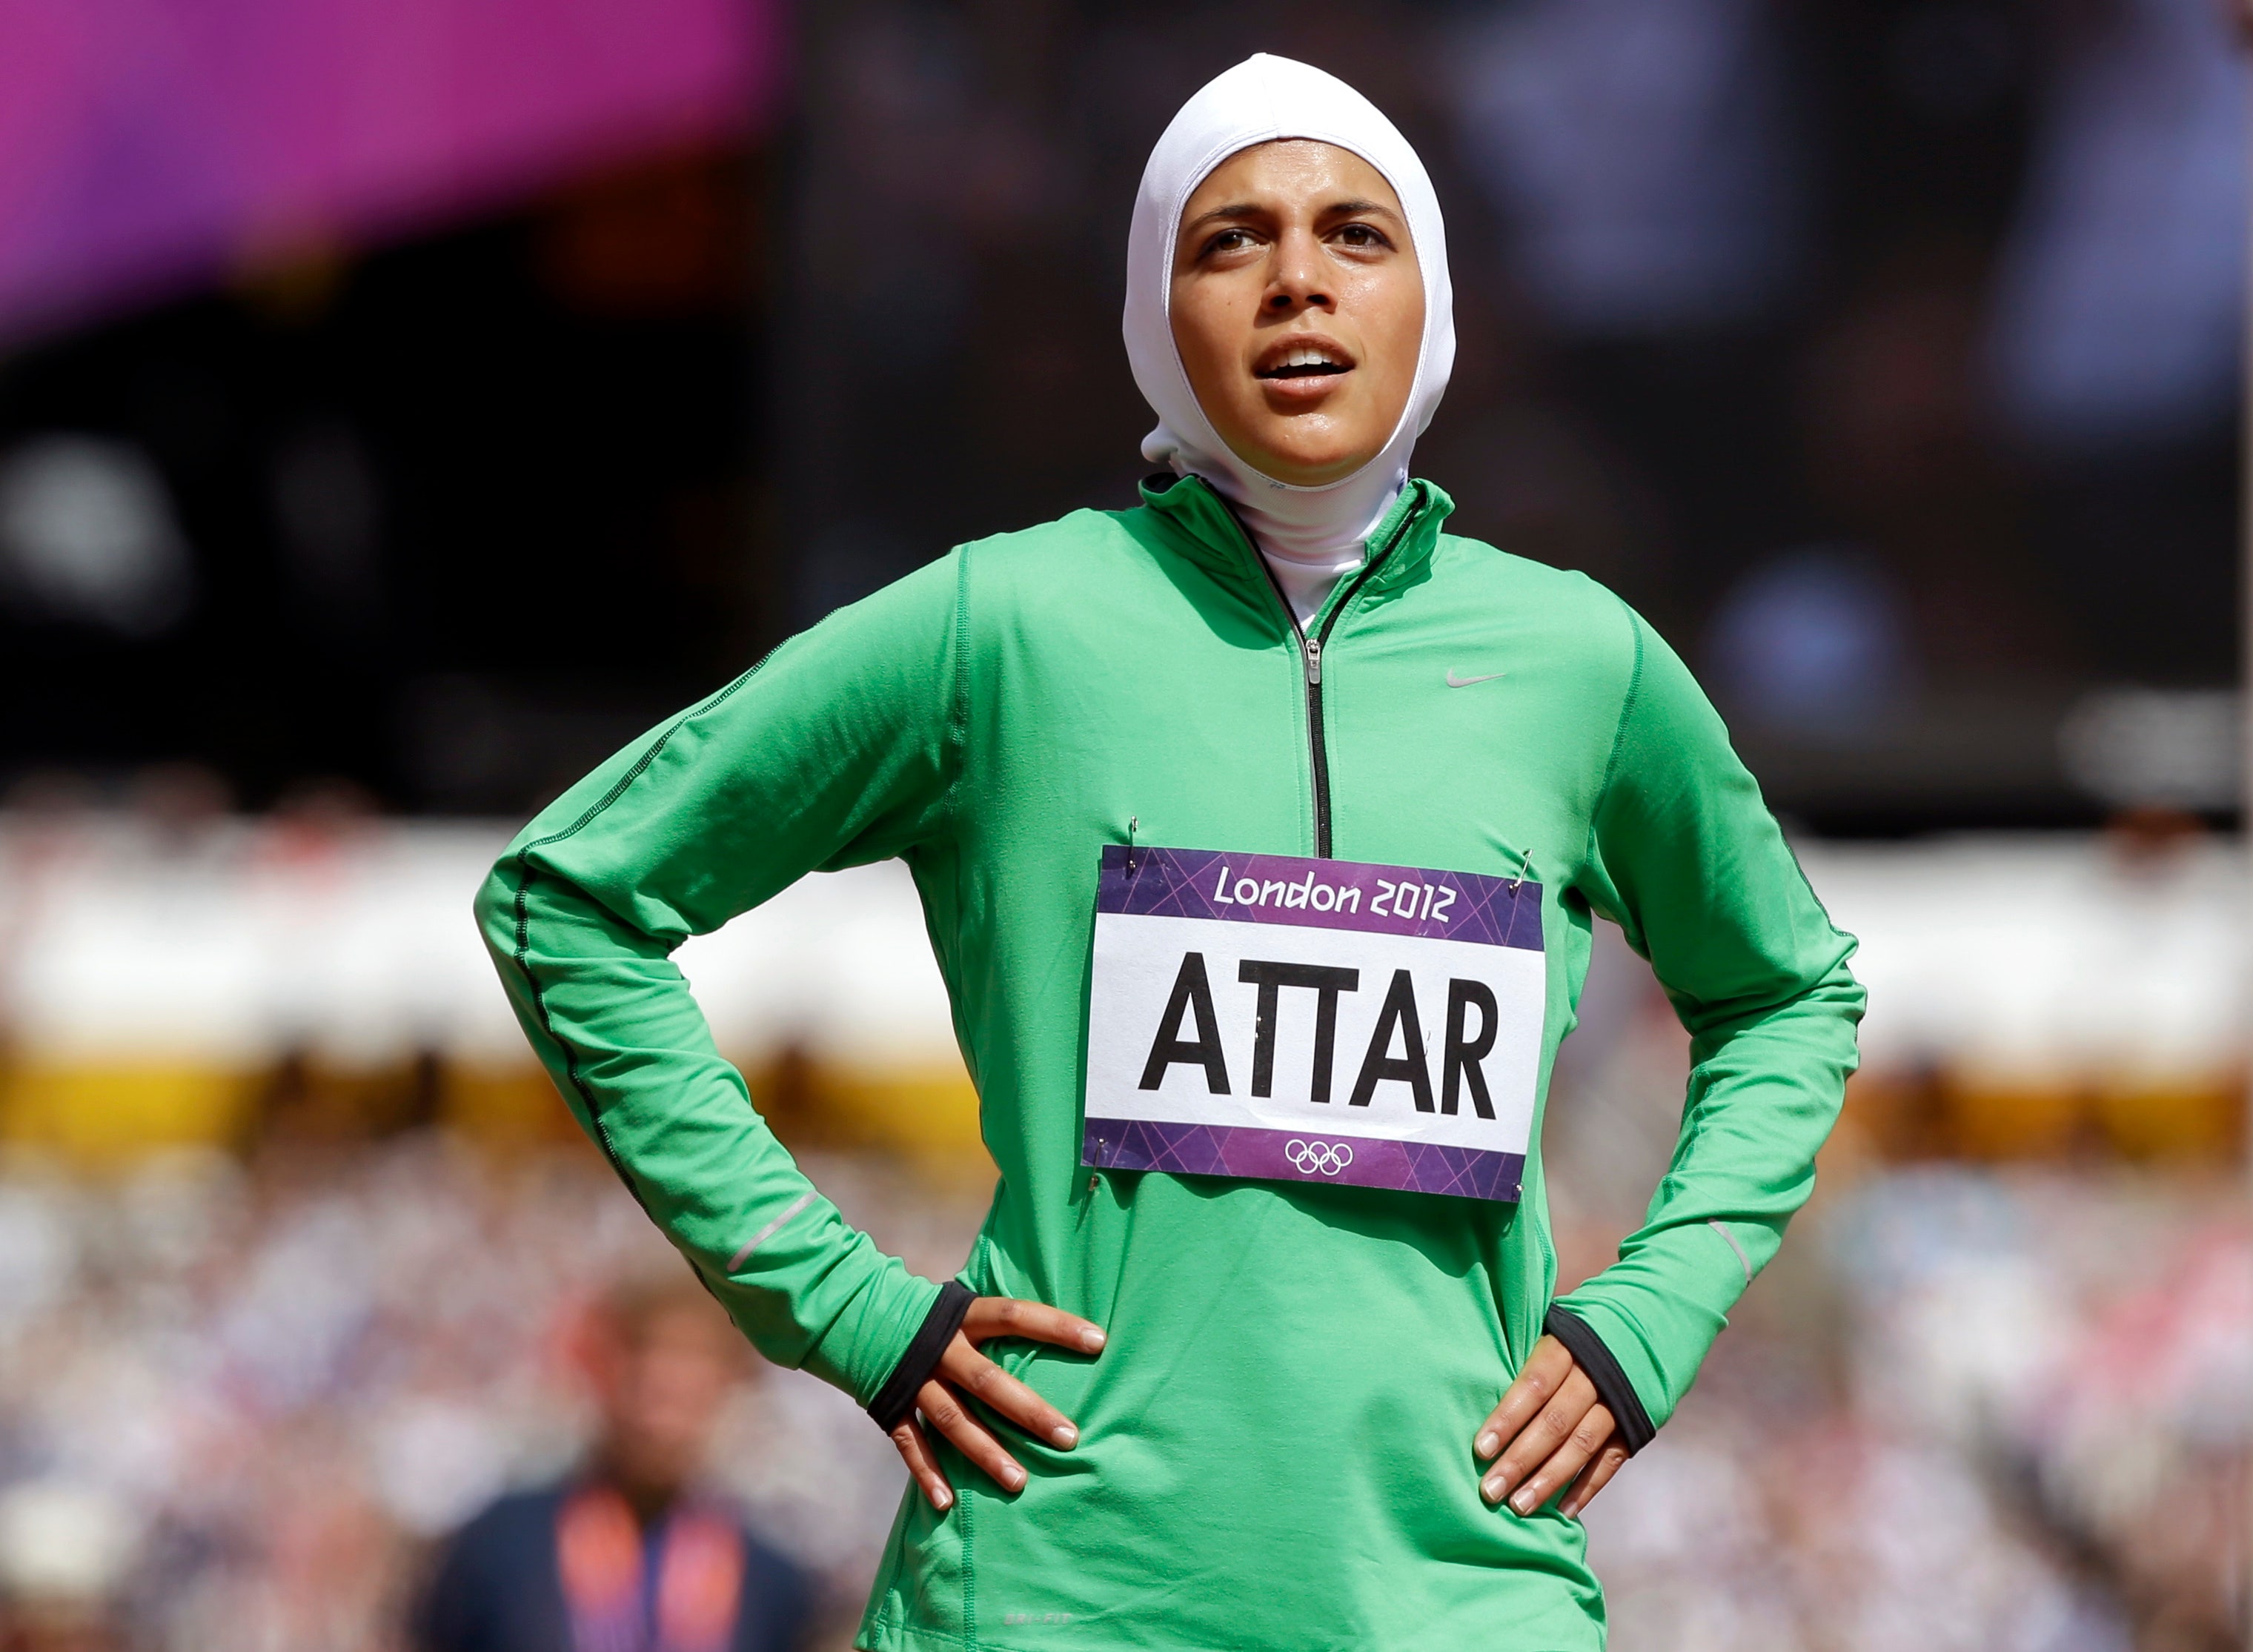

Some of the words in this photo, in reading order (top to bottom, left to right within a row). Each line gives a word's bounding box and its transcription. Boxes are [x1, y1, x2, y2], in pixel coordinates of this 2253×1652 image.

[1213, 866, 1362, 914] London
[1370, 879, 1458, 923] 2012
[1138, 952, 1499, 1121] ATTAR
[1003, 1613, 1072, 1625] DRI-FIT
